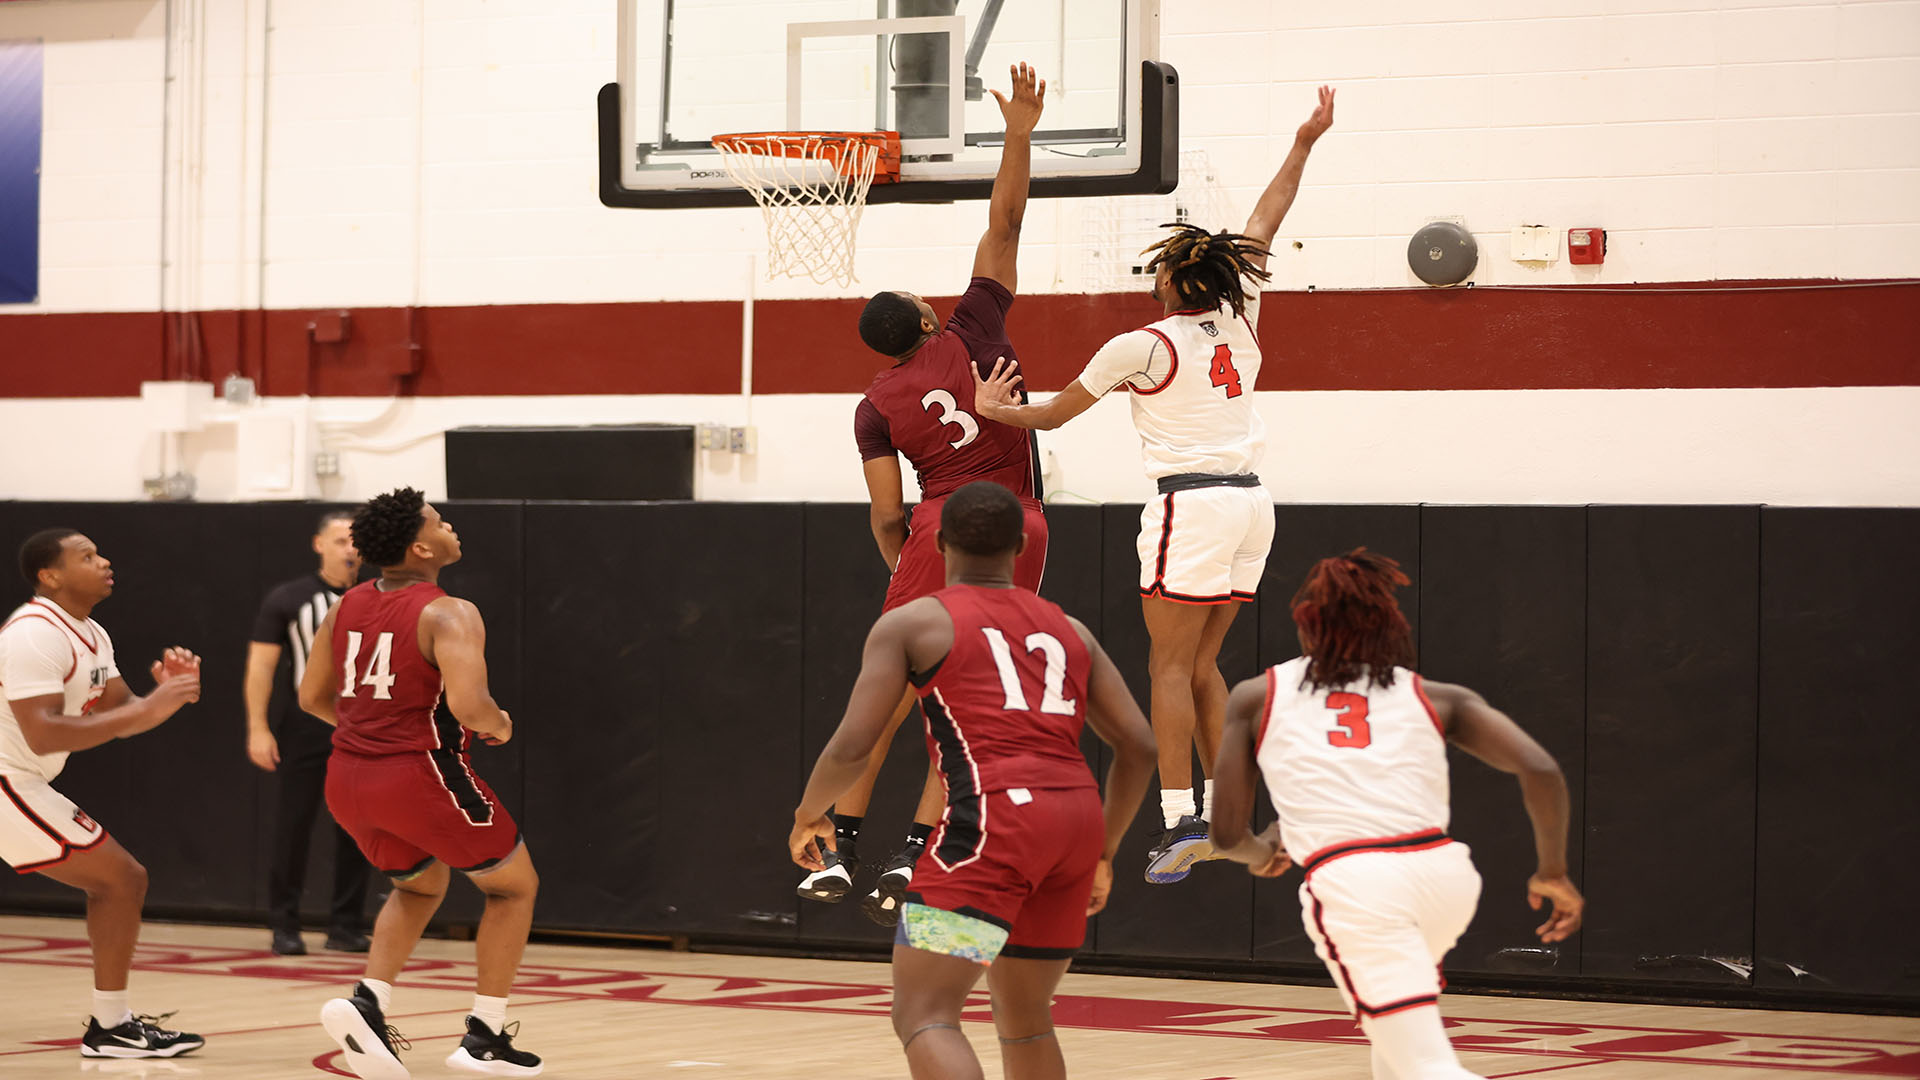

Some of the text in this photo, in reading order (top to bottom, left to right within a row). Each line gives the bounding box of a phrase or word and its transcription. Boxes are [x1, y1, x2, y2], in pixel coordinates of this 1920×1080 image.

[1209, 342, 1242, 399] 4
[921, 388, 980, 451] 3
[340, 630, 396, 700] 14
[981, 627, 1076, 716] 12
[1325, 691, 1371, 749] 3
